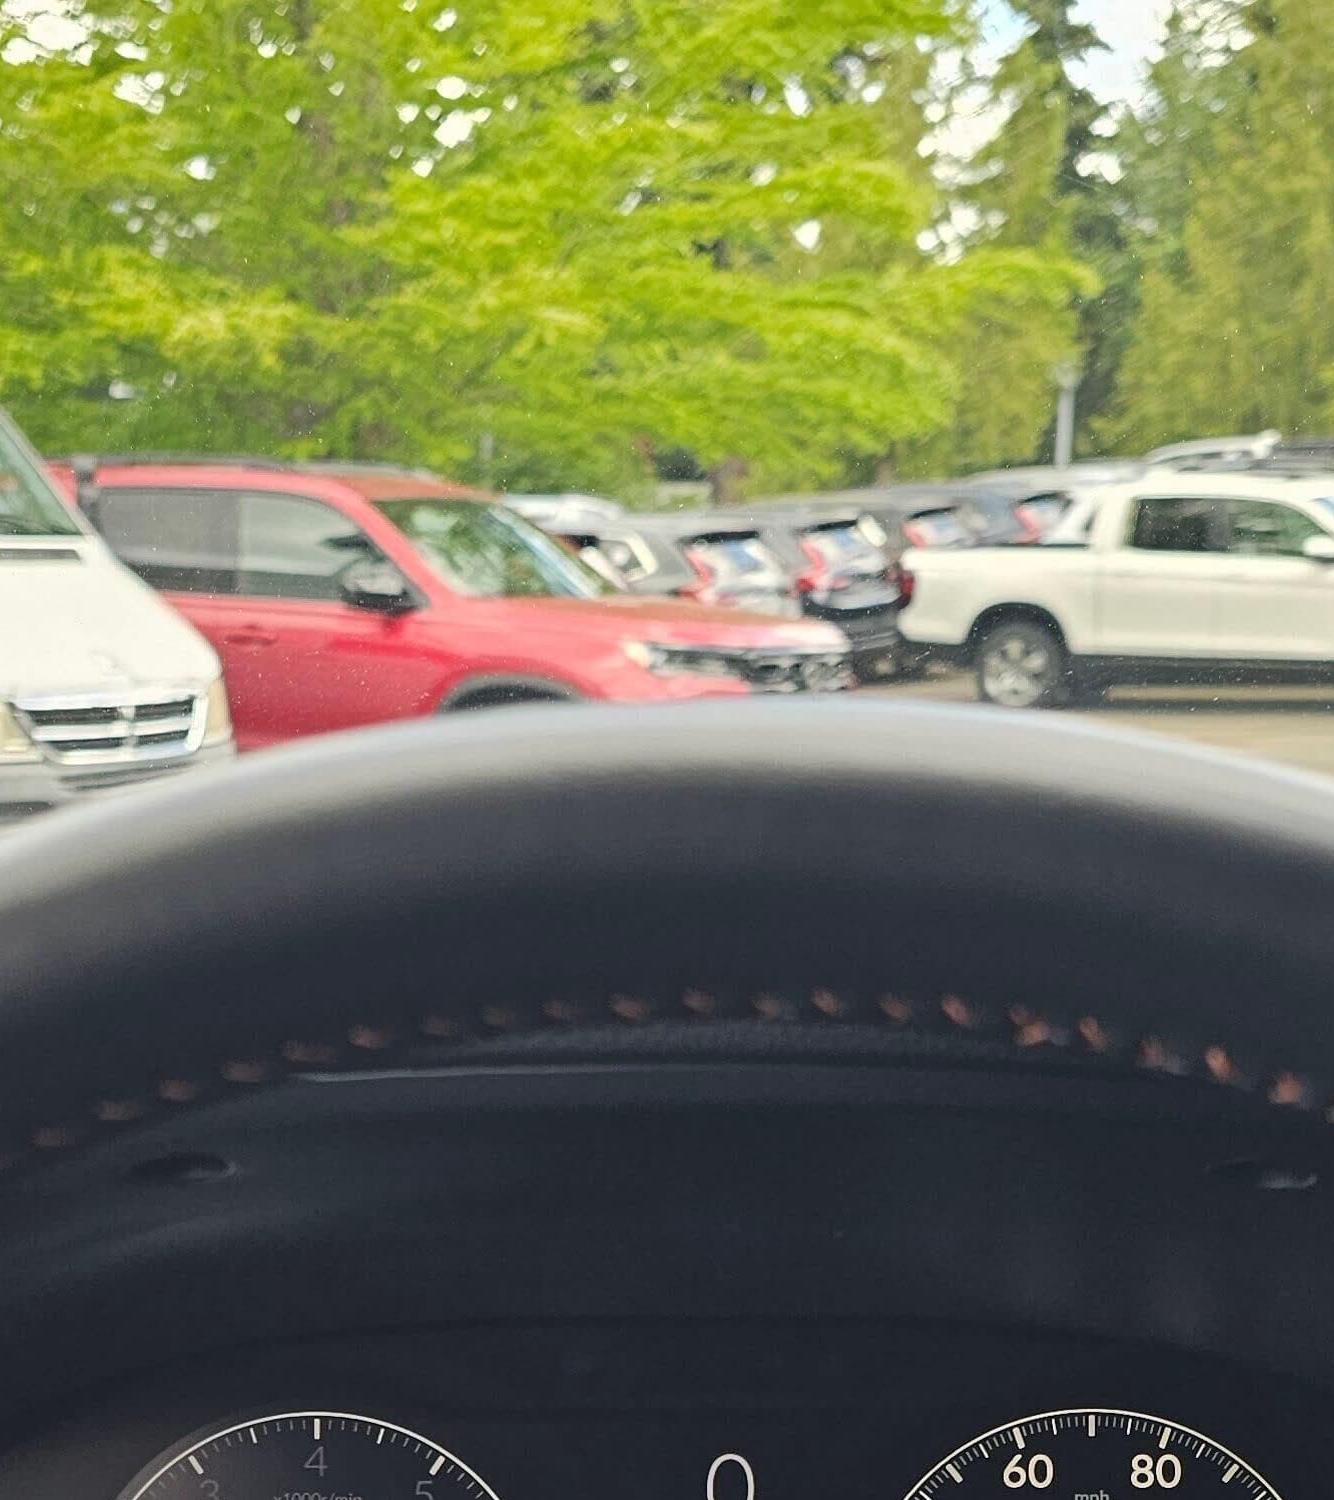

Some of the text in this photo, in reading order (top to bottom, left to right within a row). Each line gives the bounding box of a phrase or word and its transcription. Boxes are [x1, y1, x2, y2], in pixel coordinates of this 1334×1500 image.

[303, 1446, 328, 1476] 4
[1002, 1453, 1054, 1490] 60
[1129, 1453, 1182, 1490] 80
